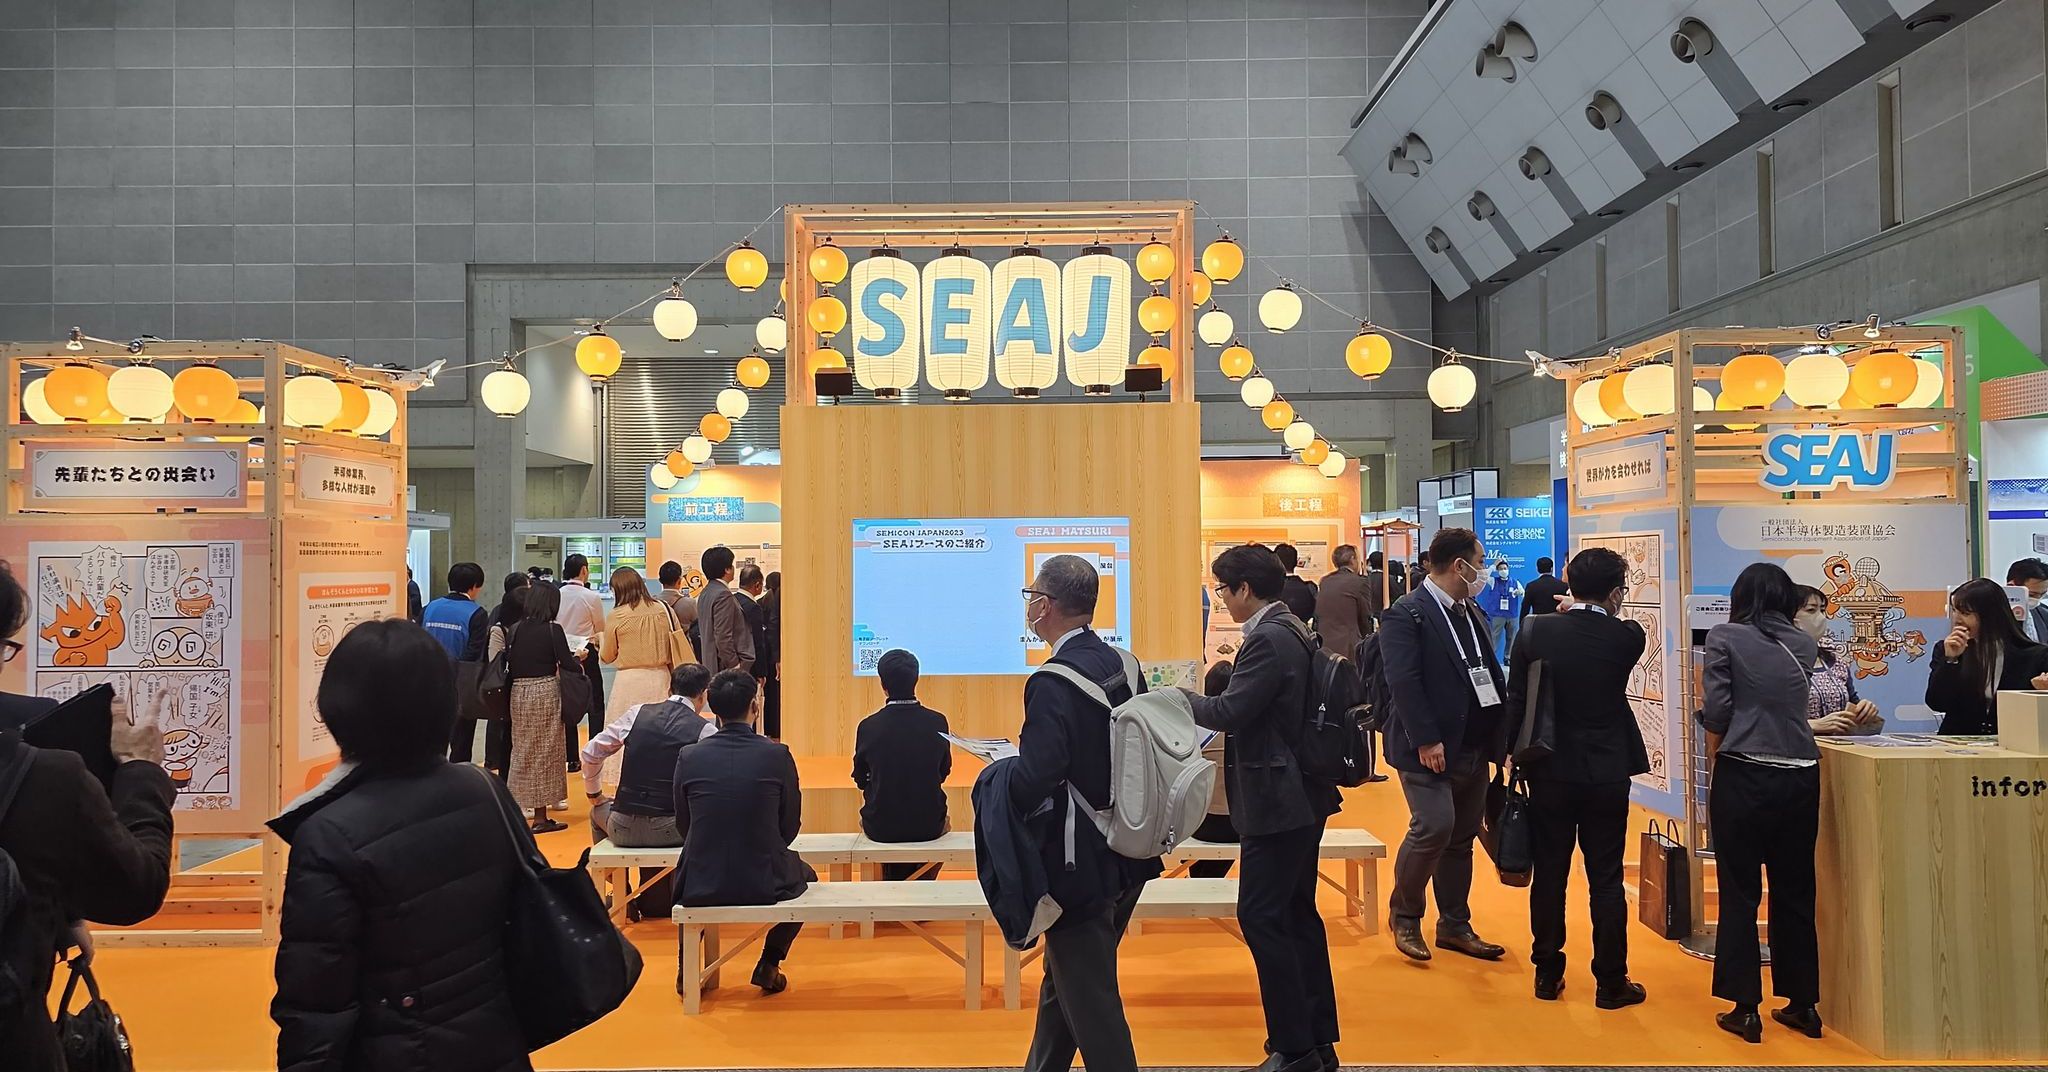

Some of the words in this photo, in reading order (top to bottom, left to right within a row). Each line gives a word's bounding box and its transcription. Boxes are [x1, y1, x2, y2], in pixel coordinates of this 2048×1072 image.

[857, 275, 1112, 357] SEAJ
[1763, 433, 1893, 487] SEAJ
[55, 465, 216, 483] 先輩たちとの出会い
[1586, 458, 1651, 483] 世界が力を合わせれば
[684, 502, 728, 516] 前工程
[1280, 498, 1322, 512] 後工程
[1515, 507, 1552, 518] SEIKE
[876, 529, 915, 537] SEMICON
[1027, 527, 1056, 536] SEAJ
[1061, 527, 1112, 536] MATSURI
[1760, 524, 1896, 537] 日本半導体製造装置協会
[97, 551, 105, 599] パワー先輩だ
[189, 684, 198, 720] 帰国子女
[1971, 775, 2047, 797] infor
